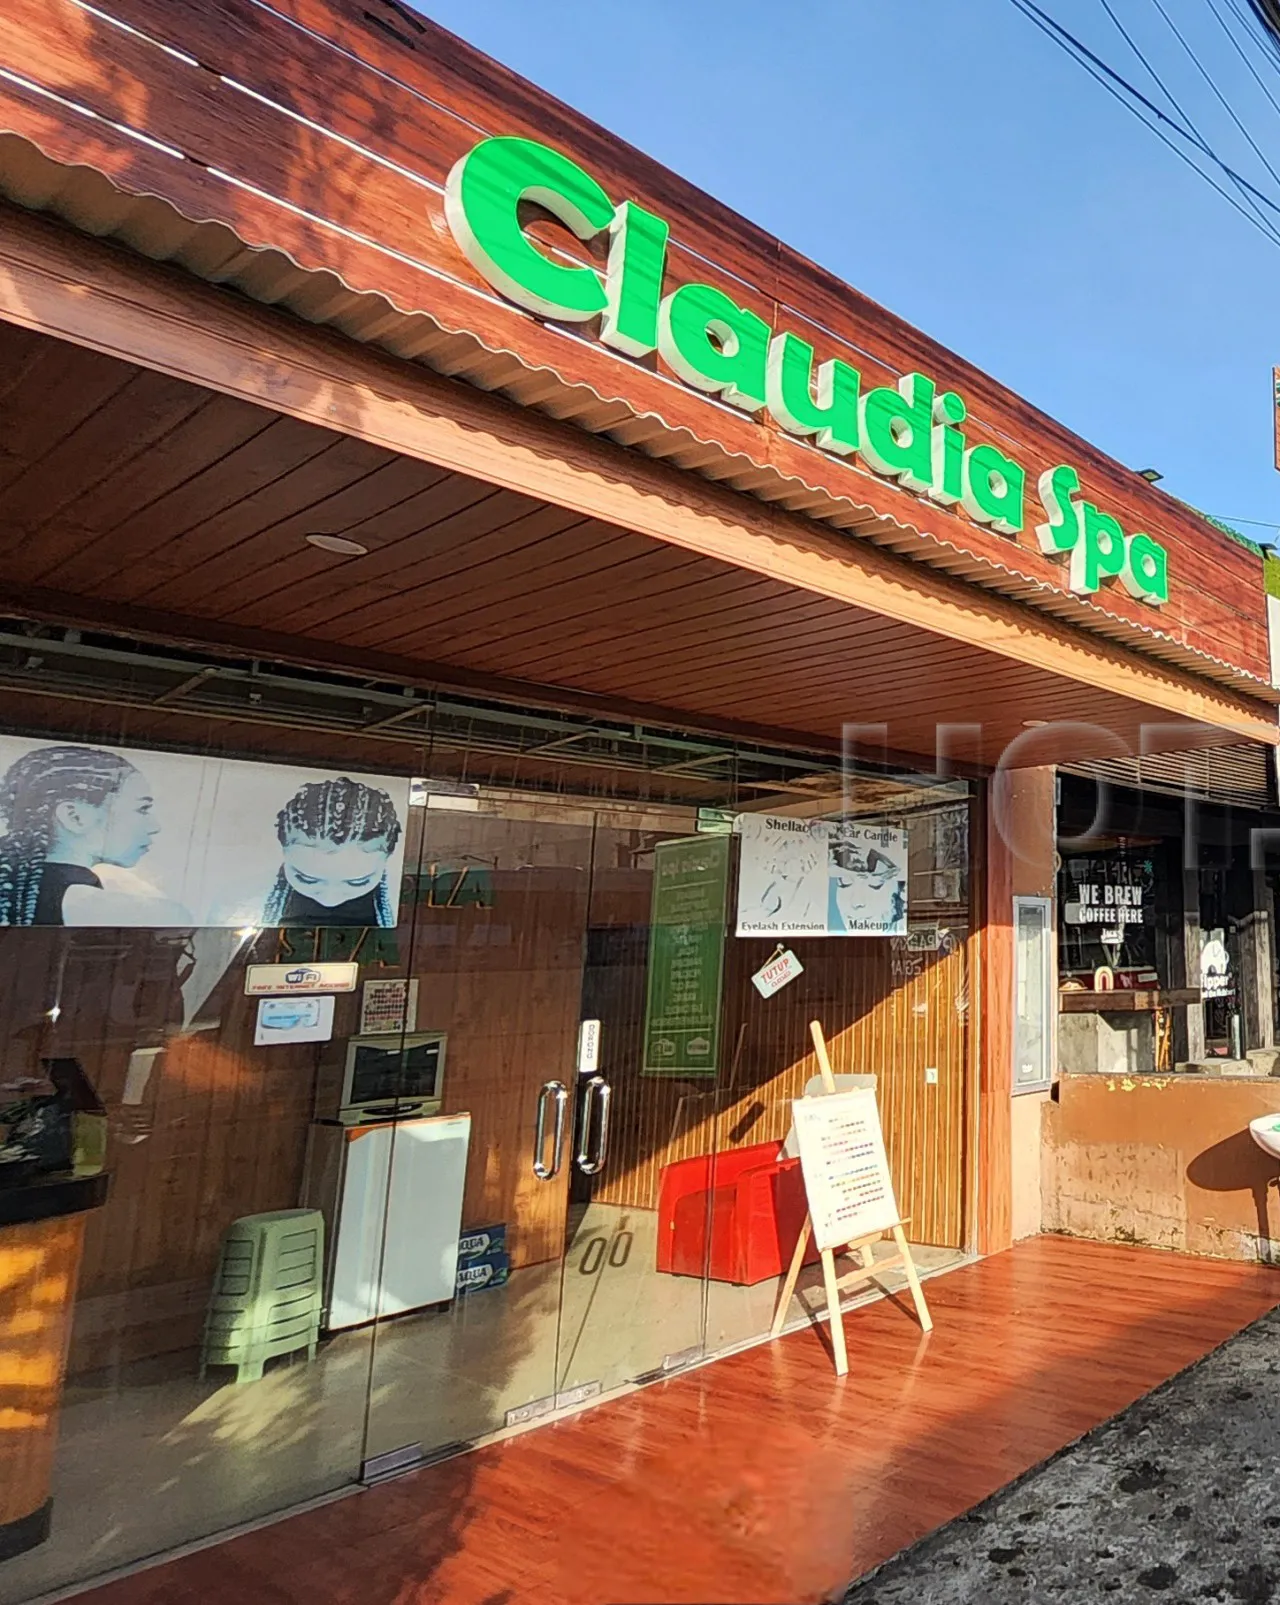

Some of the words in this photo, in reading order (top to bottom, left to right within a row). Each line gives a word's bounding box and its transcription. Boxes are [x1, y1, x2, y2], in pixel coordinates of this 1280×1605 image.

[445, 135, 1025, 535] Claudia
[1036, 464, 1169, 604] Spa
[764, 817, 810, 834] Shellac
[843, 828, 860, 840] Ear
[863, 828, 898, 843] Candle
[1079, 884, 1099, 905] WE
[1104, 885, 1142, 905] BREW
[741, 921, 778, 931] Eyelash
[781, 921, 825, 931] Extension
[849, 919, 889, 932] Makeup
[1079, 907, 1116, 923] COFFEE
[1118, 908, 1143, 923] HERE
[761, 959, 788, 984] TUTUP
